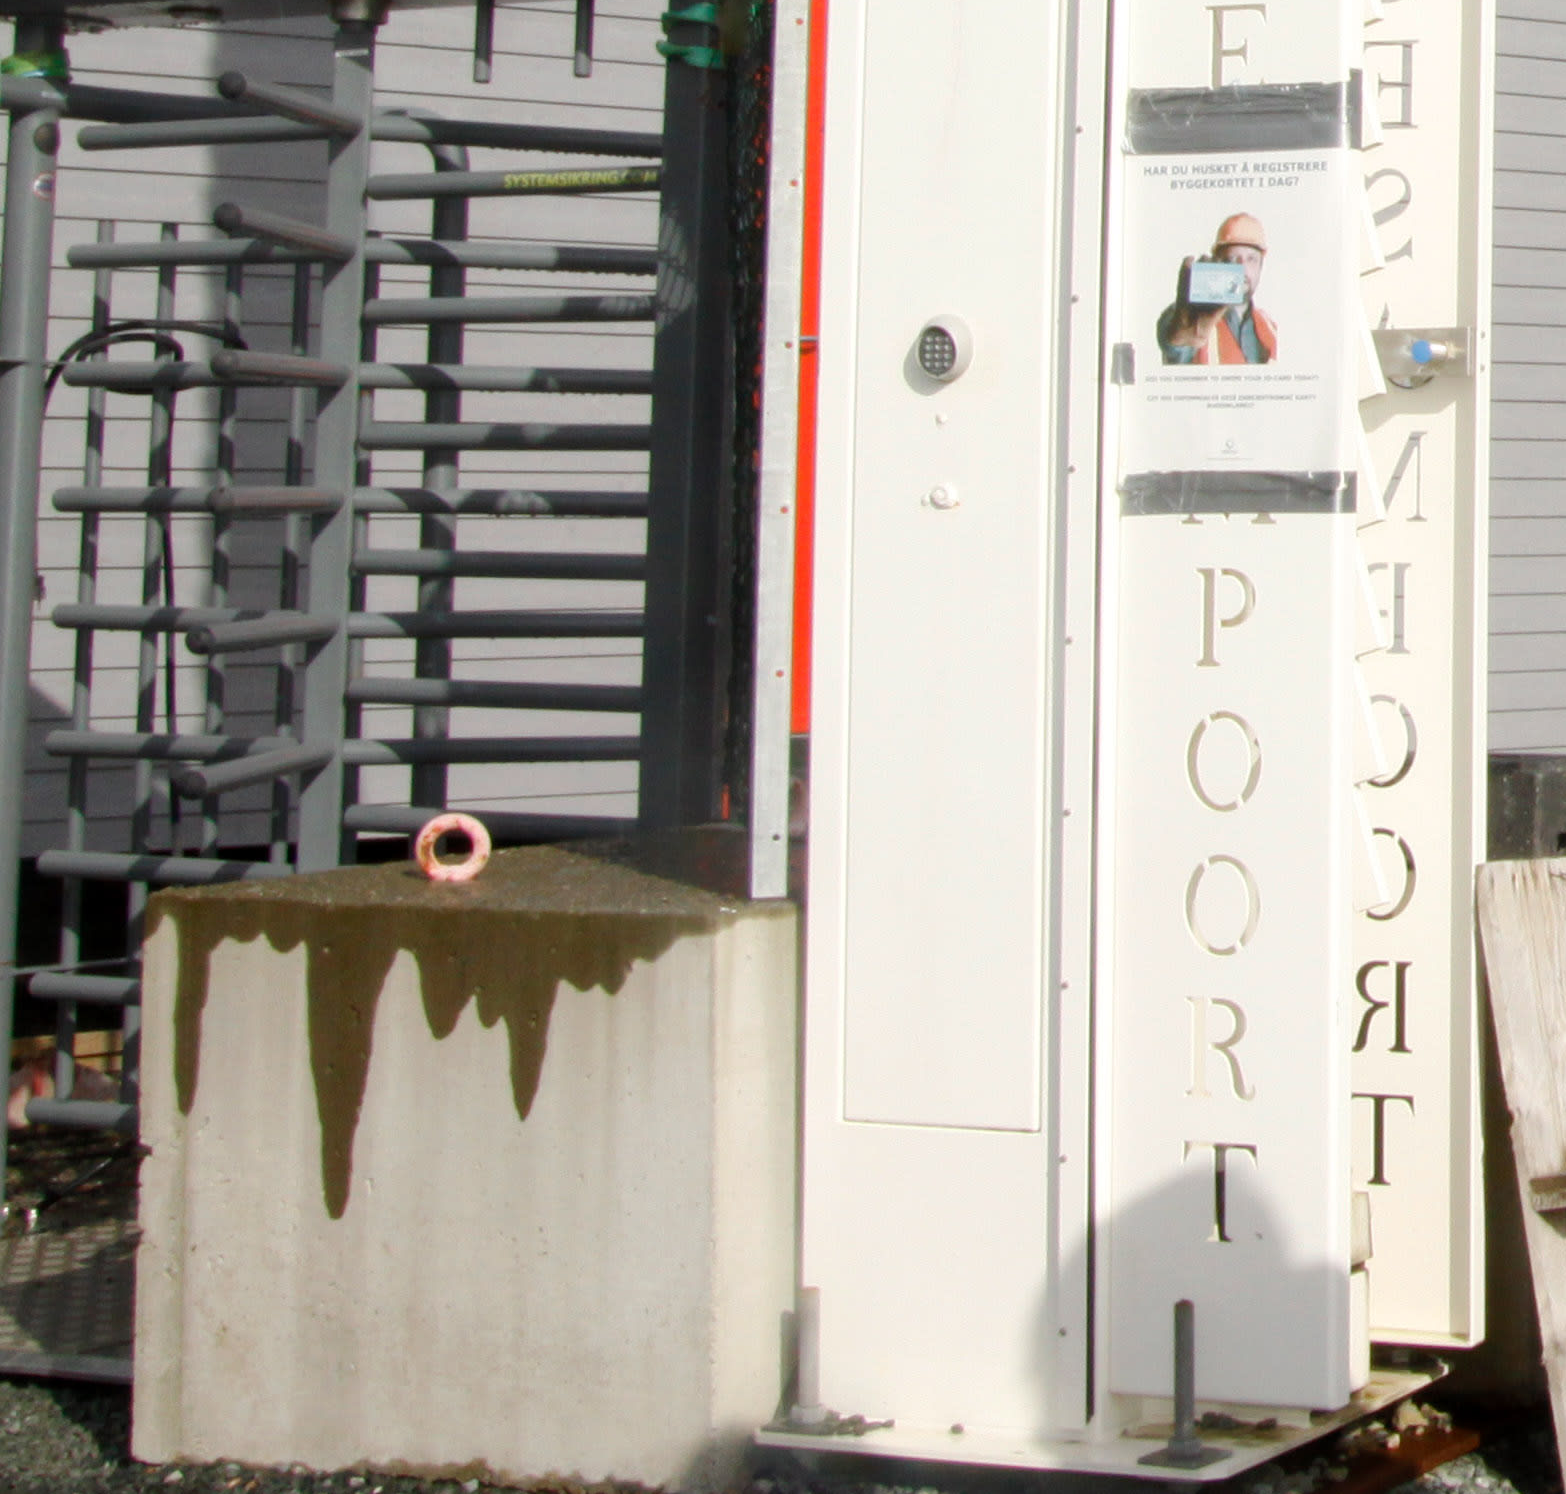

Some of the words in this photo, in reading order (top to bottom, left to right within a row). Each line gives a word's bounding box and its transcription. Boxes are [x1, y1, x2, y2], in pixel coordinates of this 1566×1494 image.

[1143, 165, 1167, 176] HAR
[1171, 164, 1188, 175] DU
[1192, 162, 1238, 175] HUSKET
[1253, 161, 1328, 173] REGISTRERE
[1170, 177, 1255, 191] BYGGEKORTET
[1269, 176, 1299, 187] DAG?
